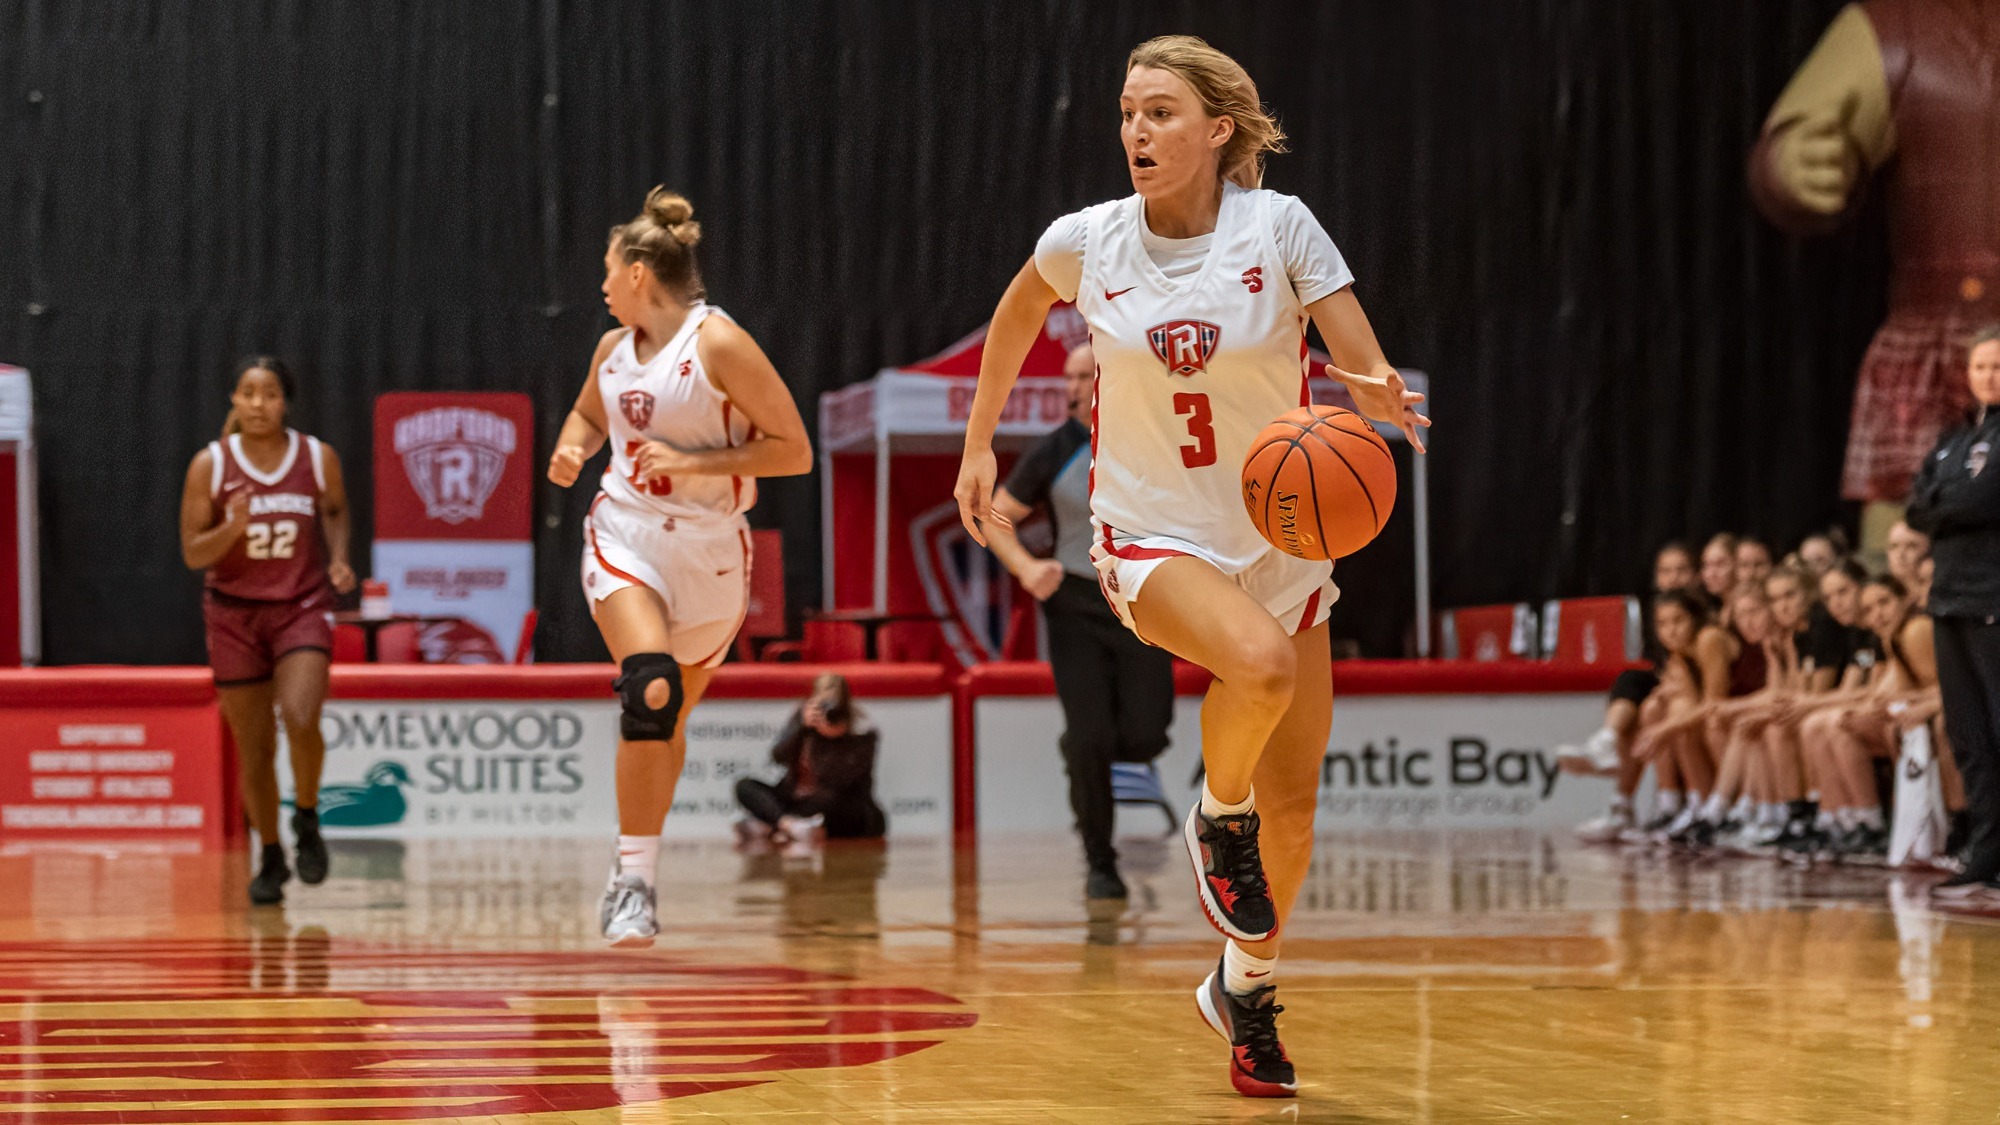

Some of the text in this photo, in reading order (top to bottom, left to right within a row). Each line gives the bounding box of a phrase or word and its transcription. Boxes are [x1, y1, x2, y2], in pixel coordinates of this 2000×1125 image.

[1169, 324, 1198, 363] R
[1173, 392, 1217, 469] 3
[246, 520, 298, 559] 22
[322, 709, 583, 750] OMEWOOD
[426, 753, 583, 794] SUITES
[1450, 737, 1559, 798] Bay
